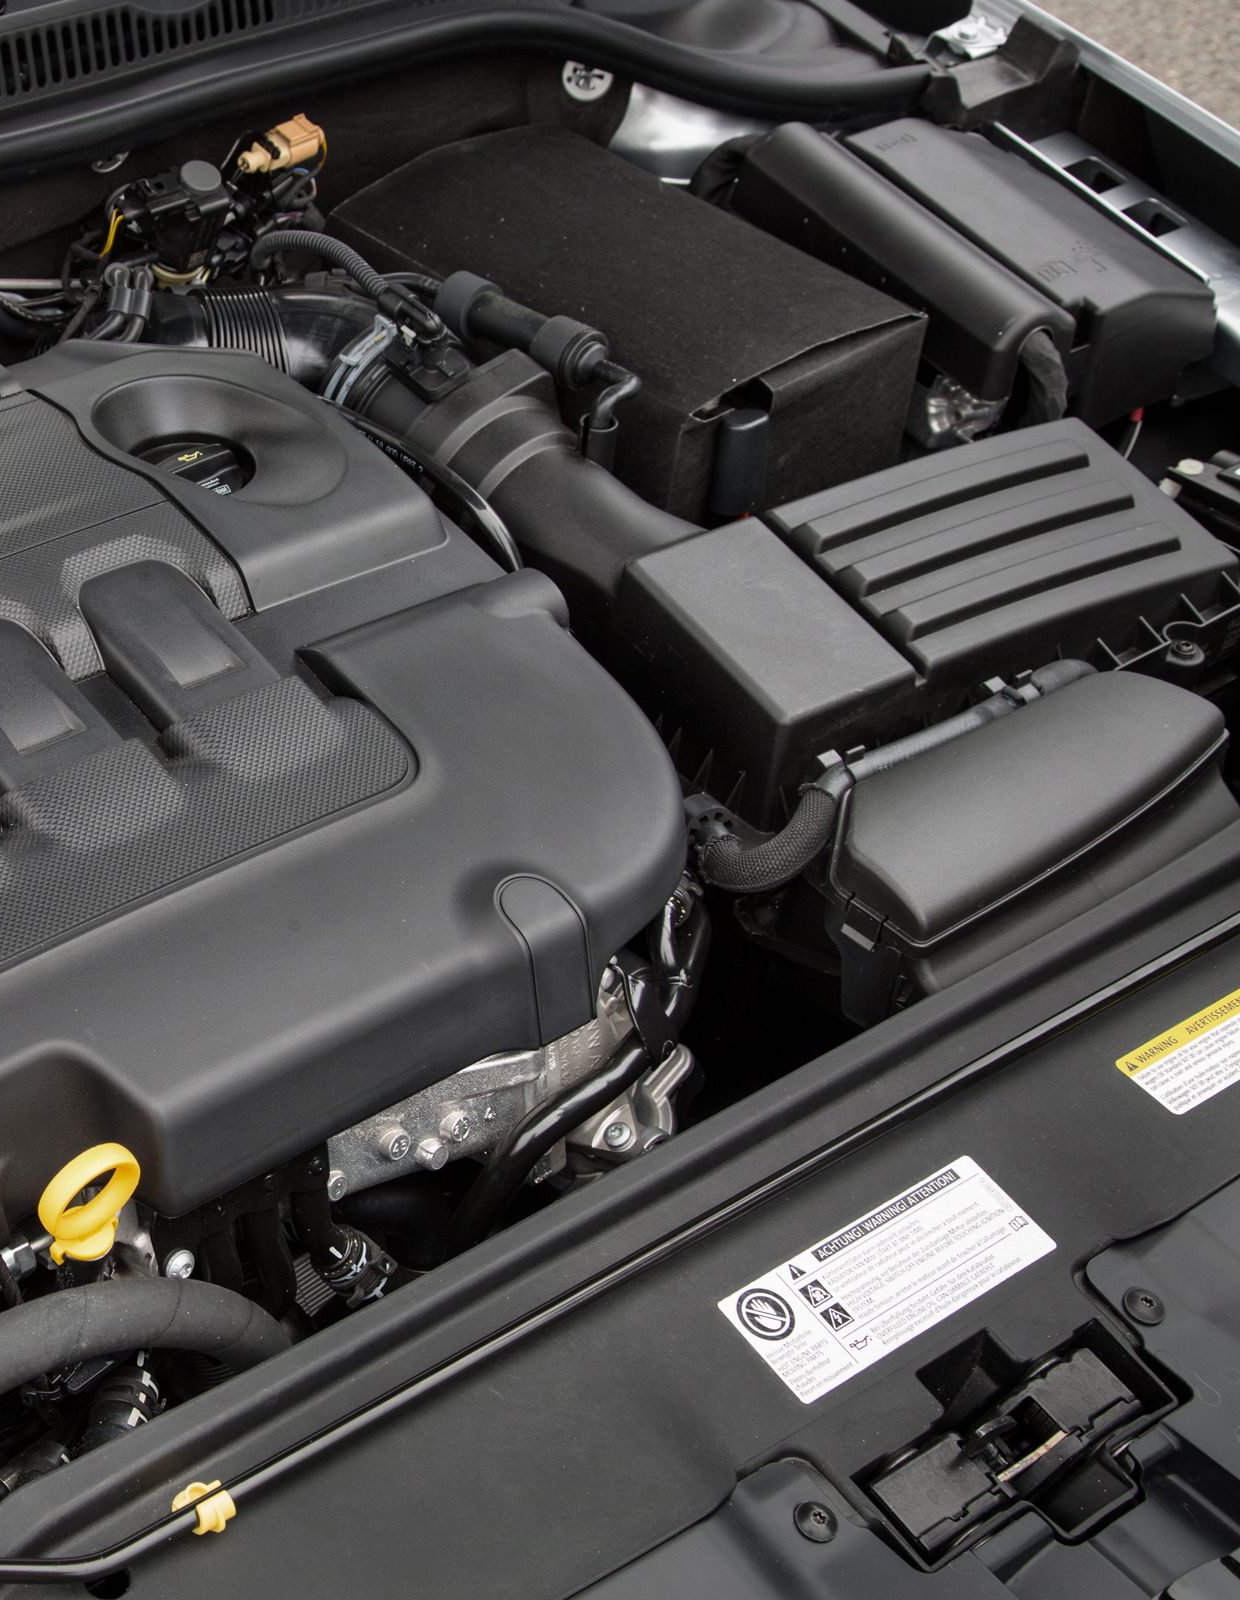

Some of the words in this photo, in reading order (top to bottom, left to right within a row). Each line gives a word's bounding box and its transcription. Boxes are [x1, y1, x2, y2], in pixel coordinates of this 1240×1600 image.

[1134, 1035, 1179, 1064] WARNING
[815, 1225, 865, 1259] ACHTUNG!
[860, 1199, 909, 1231] WARNING!
[904, 1170, 956, 1205] ATTENTION!
[776, 1361, 791, 1372] HOT
[788, 1348, 812, 1365] ENGINE
[809, 1337, 829, 1352] PARTS
[781, 1360, 807, 1378] MOVING
[805, 1349, 824, 1363] PARTS
